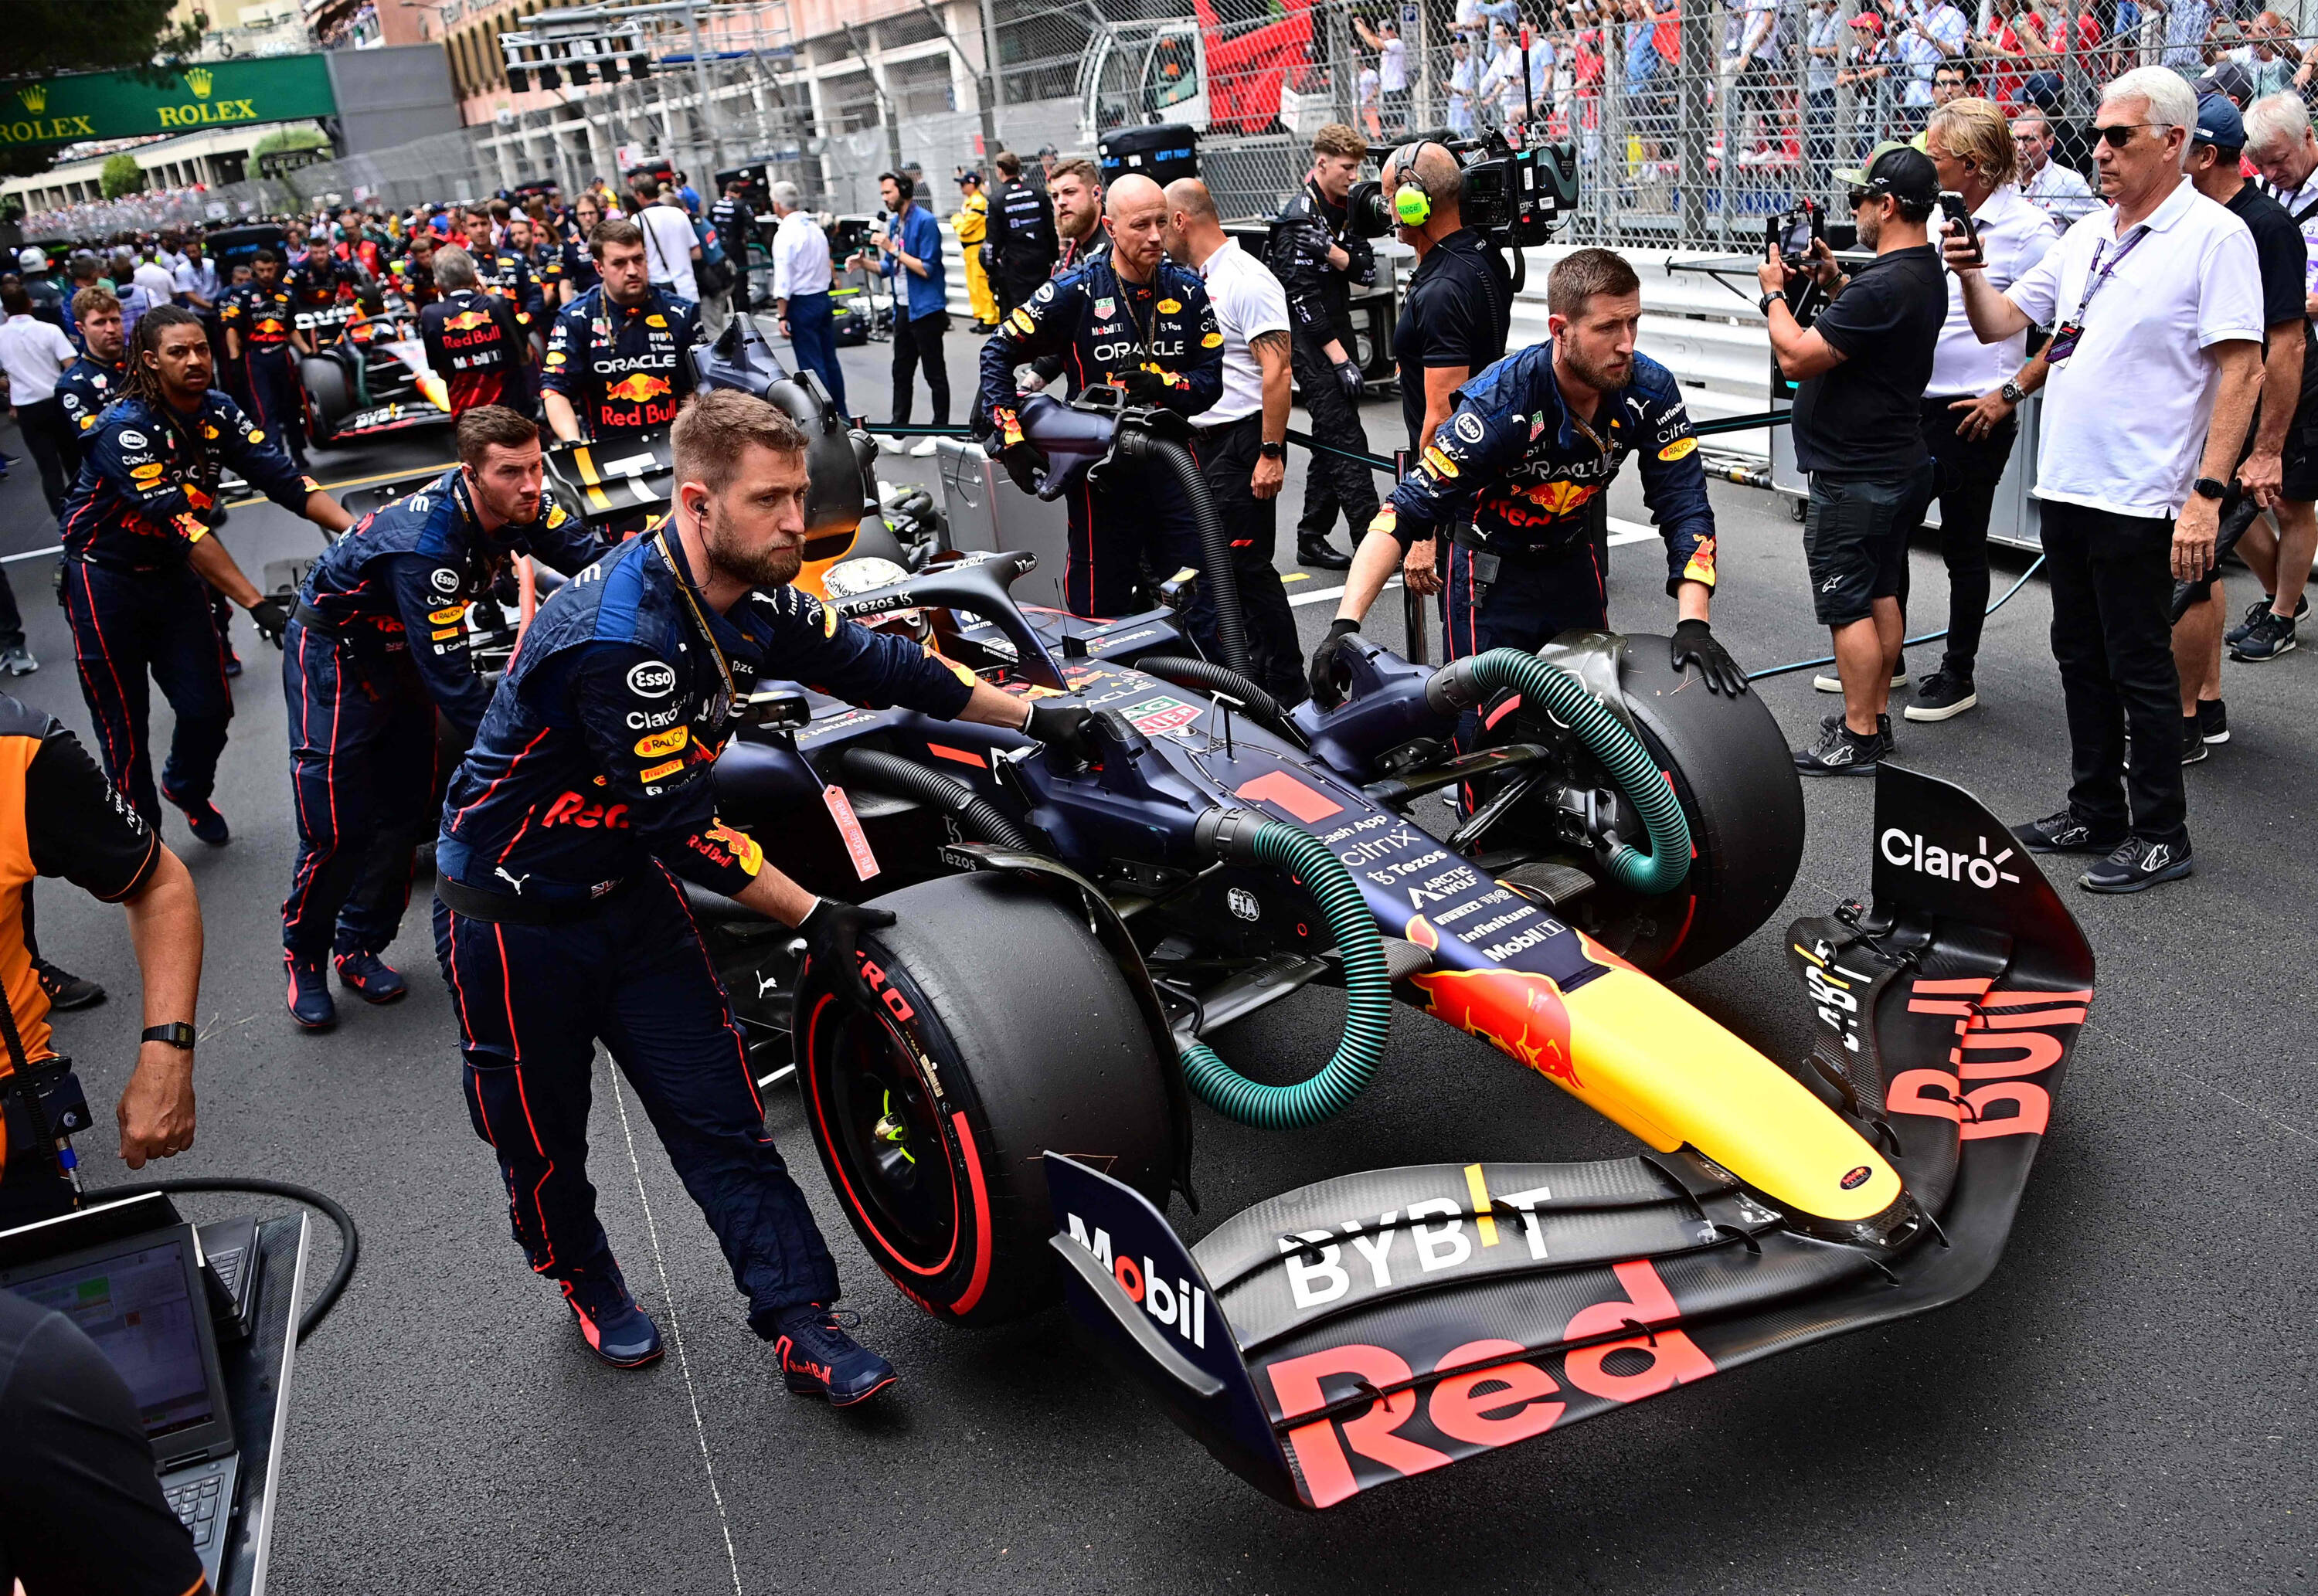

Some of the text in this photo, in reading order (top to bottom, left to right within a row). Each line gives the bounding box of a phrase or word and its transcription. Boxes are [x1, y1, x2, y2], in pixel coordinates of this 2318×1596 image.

[158, 99, 258, 127] ROLEX
[442, 324, 501, 349] Red Bull
[1091, 325, 1115, 336] Mobil
[451, 352, 489, 370] Mobil
[593, 354, 677, 374] ORACLE
[601, 398, 678, 426] Red Bull
[1668, 440, 1692, 456] RAUCH
[1433, 452, 1455, 474] RAUCH
[439, 609, 461, 620] RAUCH
[850, 596, 895, 614] Tezos
[998, 669, 1004, 681] 1
[1084, 681, 1157, 709] ACLE
[626, 707, 678, 730] Claro
[652, 728, 685, 750] RAUCH
[1234, 769, 1345, 824] 1
[834, 799, 874, 873] REMOVE BEFORE RUN
[1316, 813, 1388, 846] Cash App
[1341, 820, 1422, 867] Citrix
[708, 847, 736, 868] Bull
[937, 846, 977, 871] Tezos
[1387, 849, 1449, 878] Tezos
[1881, 827, 1997, 889] Claro
[1424, 866, 1473, 892] ARCTIC
[1439, 876, 1479, 898] WOLF
[1433, 900, 1484, 926] PIRELLI
[1457, 904, 1538, 944] infinitum
[1481, 918, 1567, 963] Mobil 1
[858, 953, 915, 1022] RO
[1279, 1162, 1552, 1311] BYBIT
[1067, 1211, 1206, 1350] Mobil
[790, 1360, 814, 1378] Red
[1265, 1258, 1718, 1509] Red
